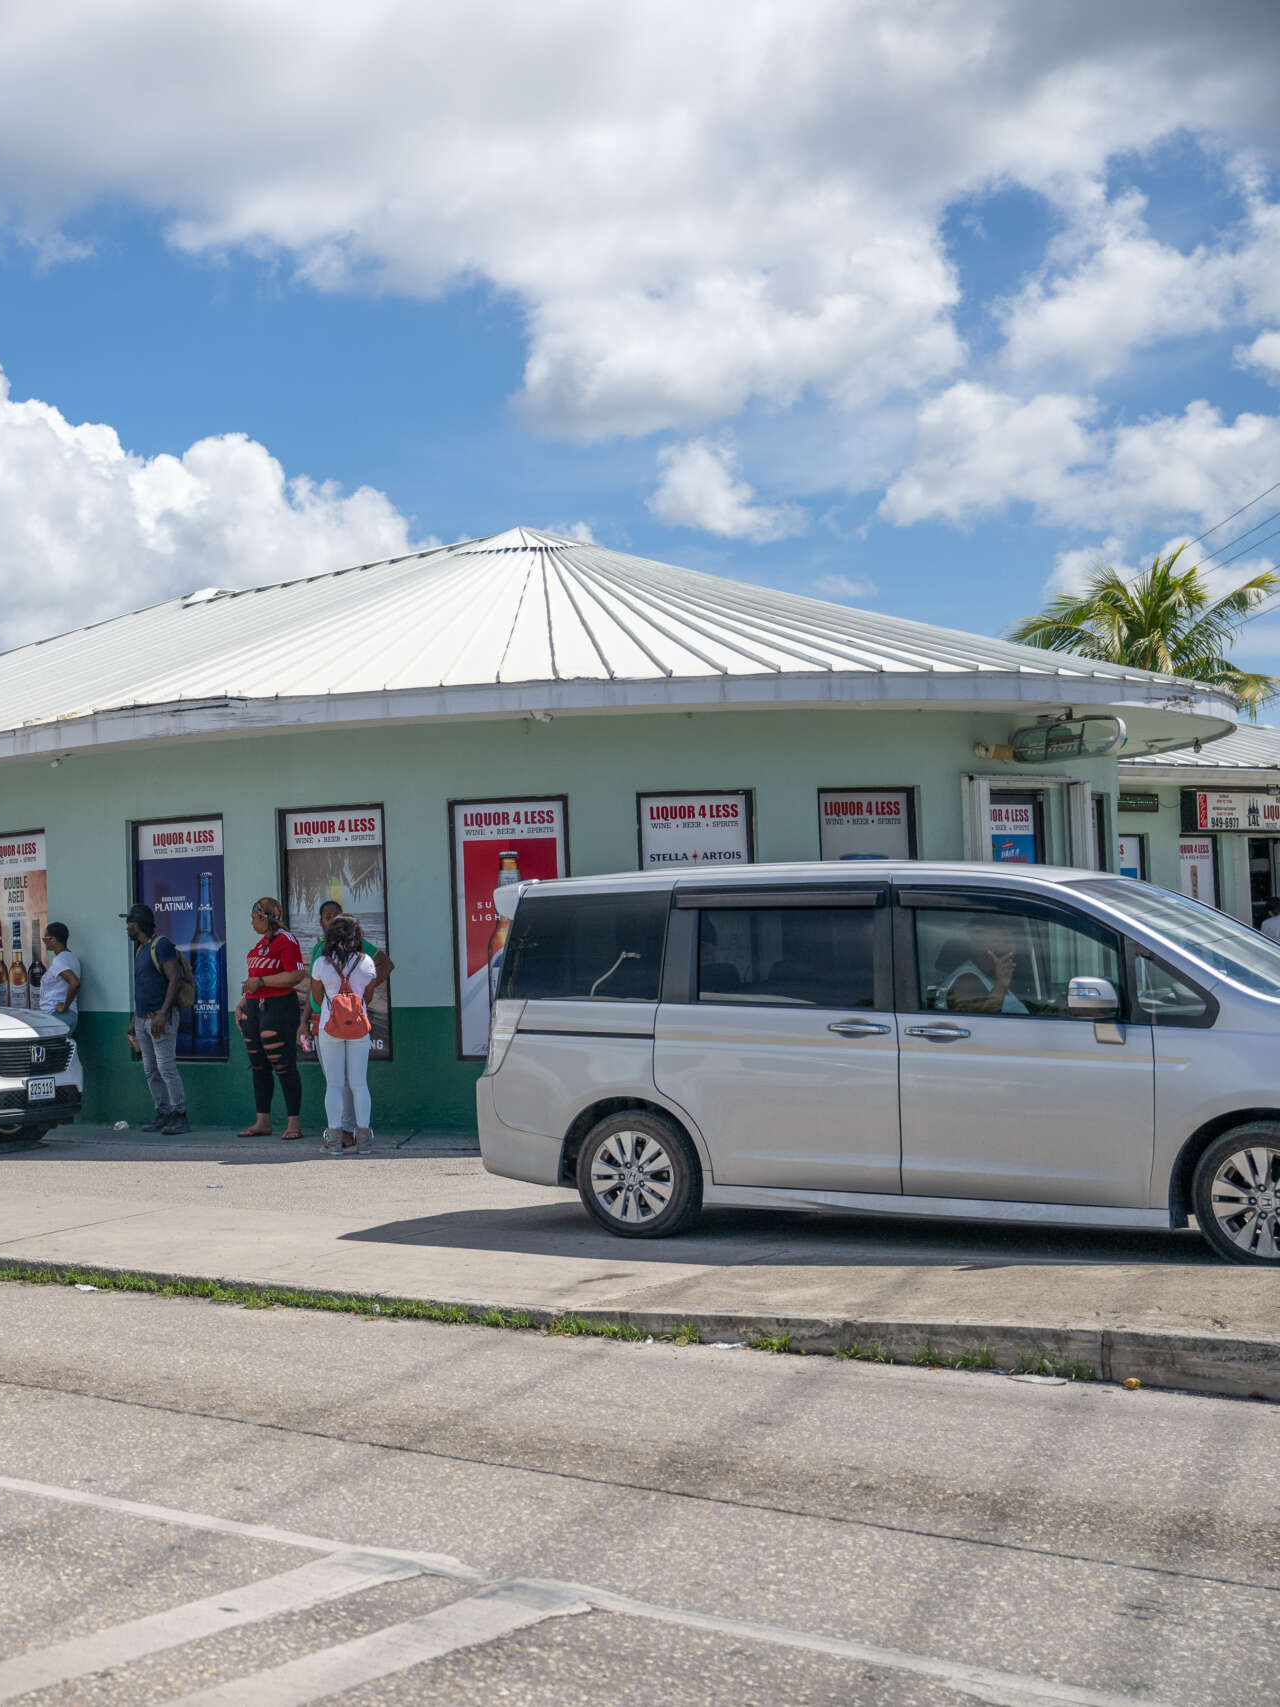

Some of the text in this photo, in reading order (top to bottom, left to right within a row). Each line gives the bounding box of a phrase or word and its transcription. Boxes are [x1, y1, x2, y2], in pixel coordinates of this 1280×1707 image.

[649, 803, 739, 821] LIQUOR 4 LESS
[824, 800, 900, 817] LIQUOR 4 LESS
[1004, 808, 1010, 822] 4
[1011, 808, 1029, 822] LESS
[1263, 805, 1280, 821] LIQU
[463, 809, 555, 828] LIQUOR 4 LESS
[682, 821, 701, 829] BEER
[712, 820, 739, 828] SPIRITS
[293, 817, 376, 836] LIQUOR 4 LESS
[464, 826, 555, 836] WINE BEER SPIRITS
[152, 829, 215, 848] LIQUOR 4 LESS
[16, 843, 21, 855] 4
[21, 842, 37, 856] LESS
[649, 851, 742, 862] STELLA ARTOIS
[3, 875, 29, 890] DOUBLE
[7, 890, 25, 904] AGED
[154, 901, 193, 912] PLATINUM
[476, 901, 492, 909] SU
[471, 913, 501, 922] LIGH
[194, 1003, 220, 1011] PLATINUM
